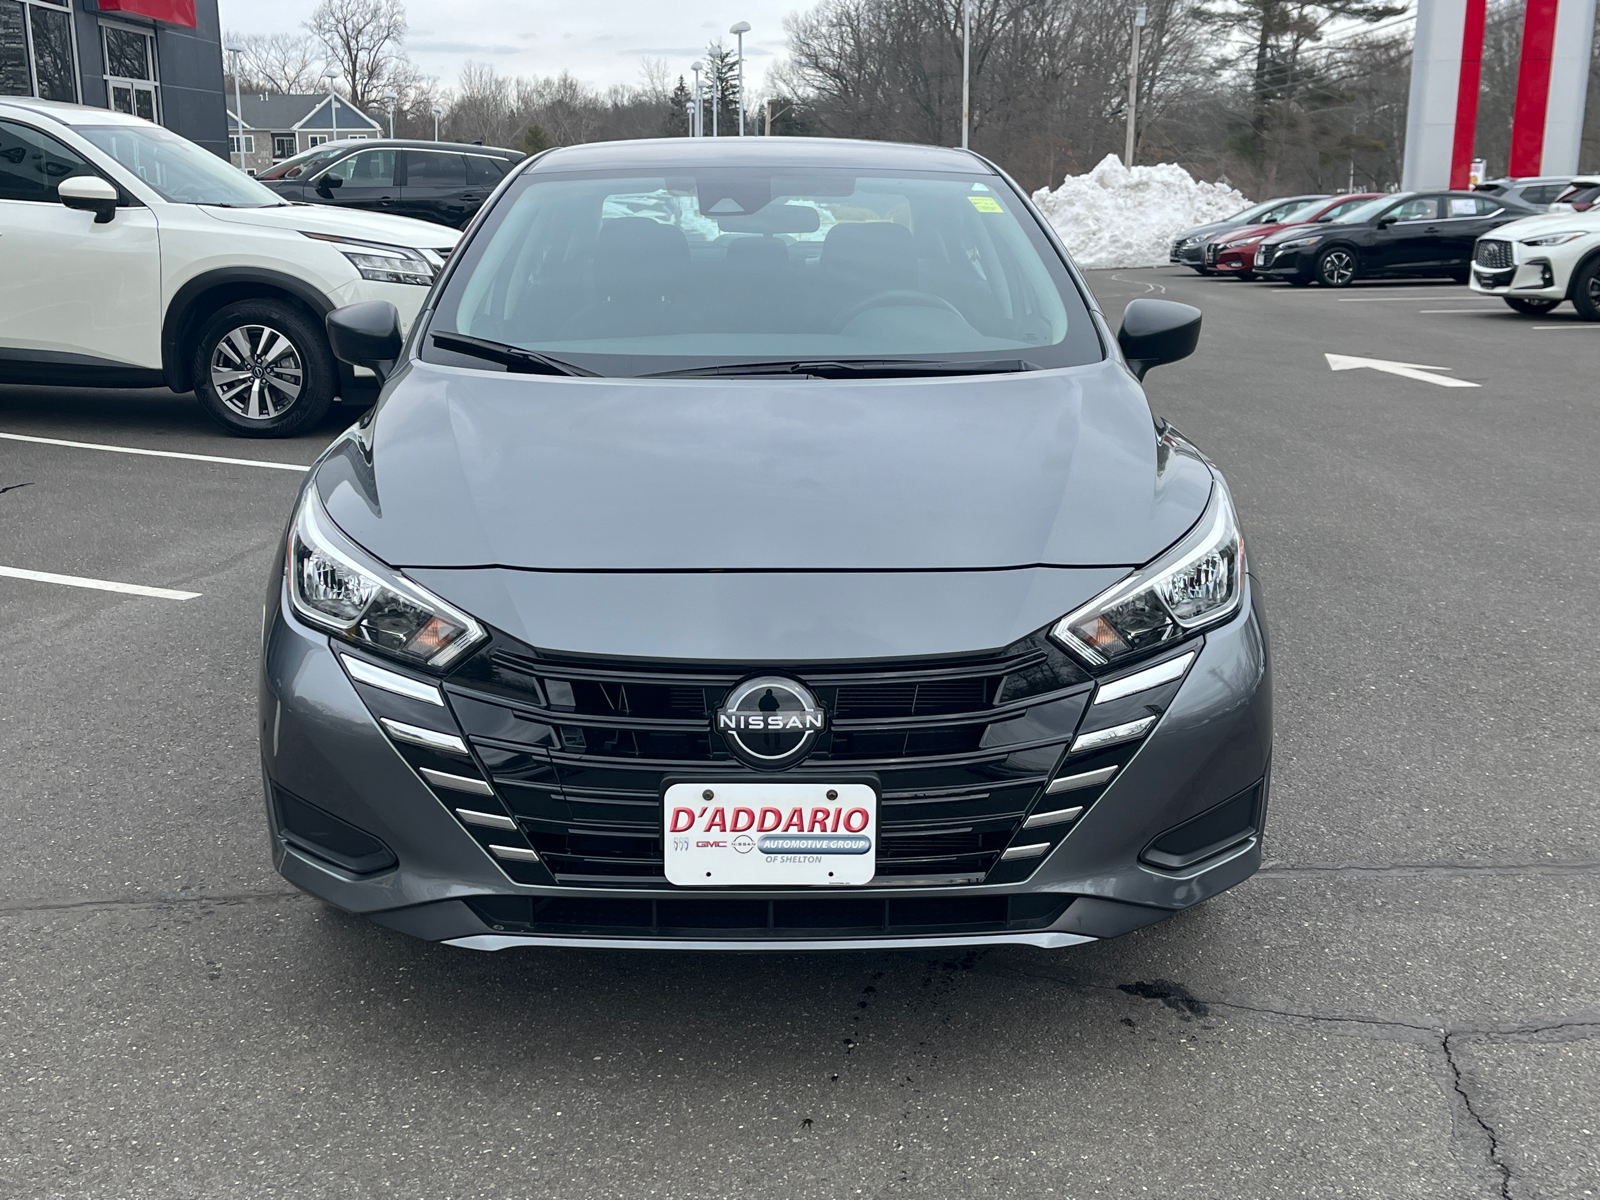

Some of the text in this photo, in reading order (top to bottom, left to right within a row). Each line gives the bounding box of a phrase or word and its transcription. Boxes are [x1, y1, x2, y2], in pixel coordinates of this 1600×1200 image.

[720, 714, 822, 729] NISSAN
[669, 806, 870, 833] D'ADDARIO
[763, 840, 866, 849] AUTOMOTIVE GROUP
[765, 855, 822, 863] OF SHELTON
